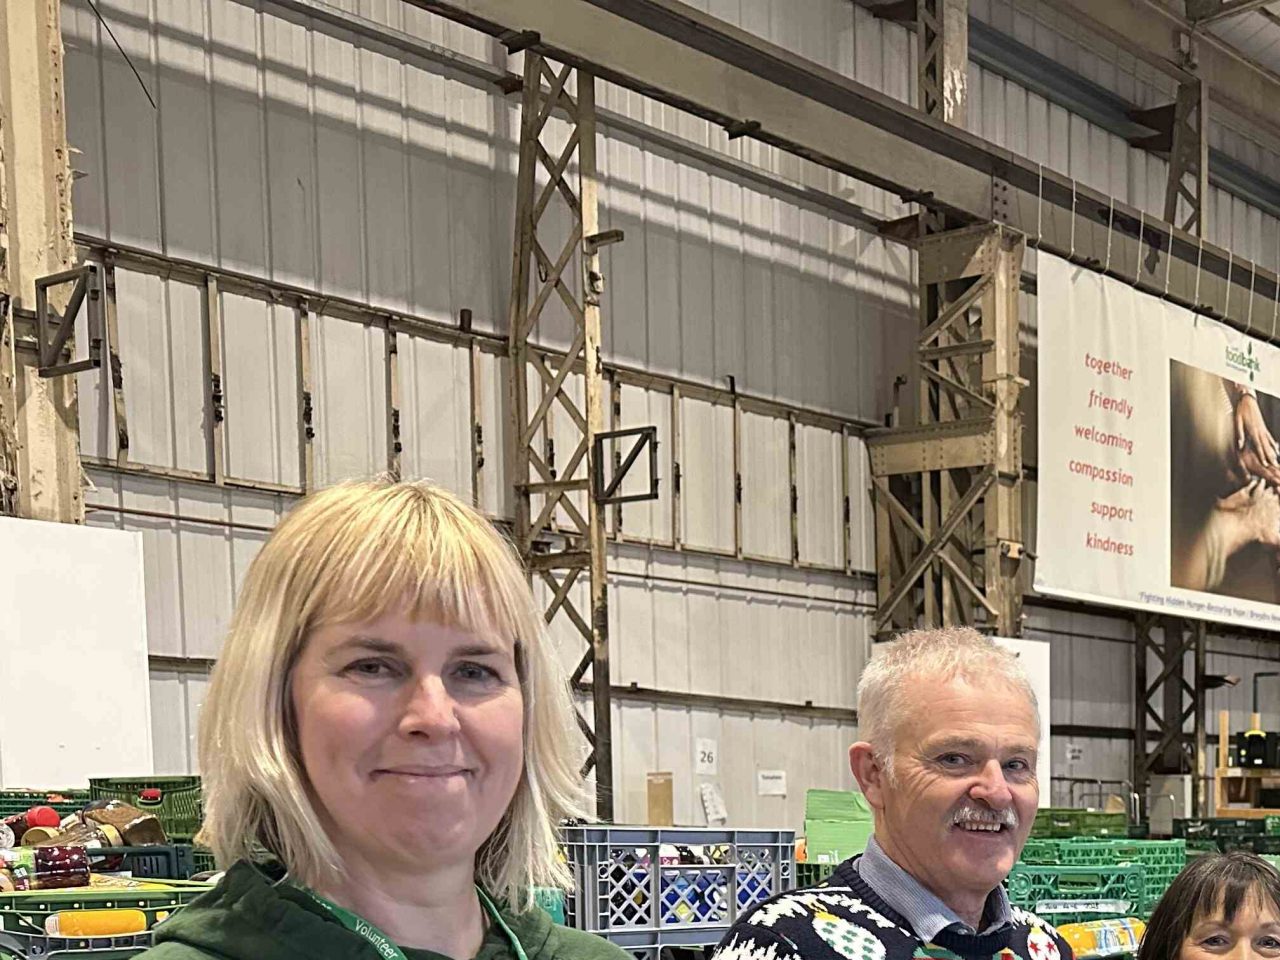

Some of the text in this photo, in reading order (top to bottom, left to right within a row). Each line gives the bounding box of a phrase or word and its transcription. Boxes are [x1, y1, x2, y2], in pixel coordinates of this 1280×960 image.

[1085, 352, 1133, 380] together
[1088, 389, 1133, 420] friendly
[1074, 424, 1133, 456] welcoming
[1069, 460, 1133, 488] compassion
[1091, 501, 1133, 522] support
[1086, 531, 1134, 556] kindness
[700, 751, 714, 764] 26
[355, 918, 399, 960] Volunteer
